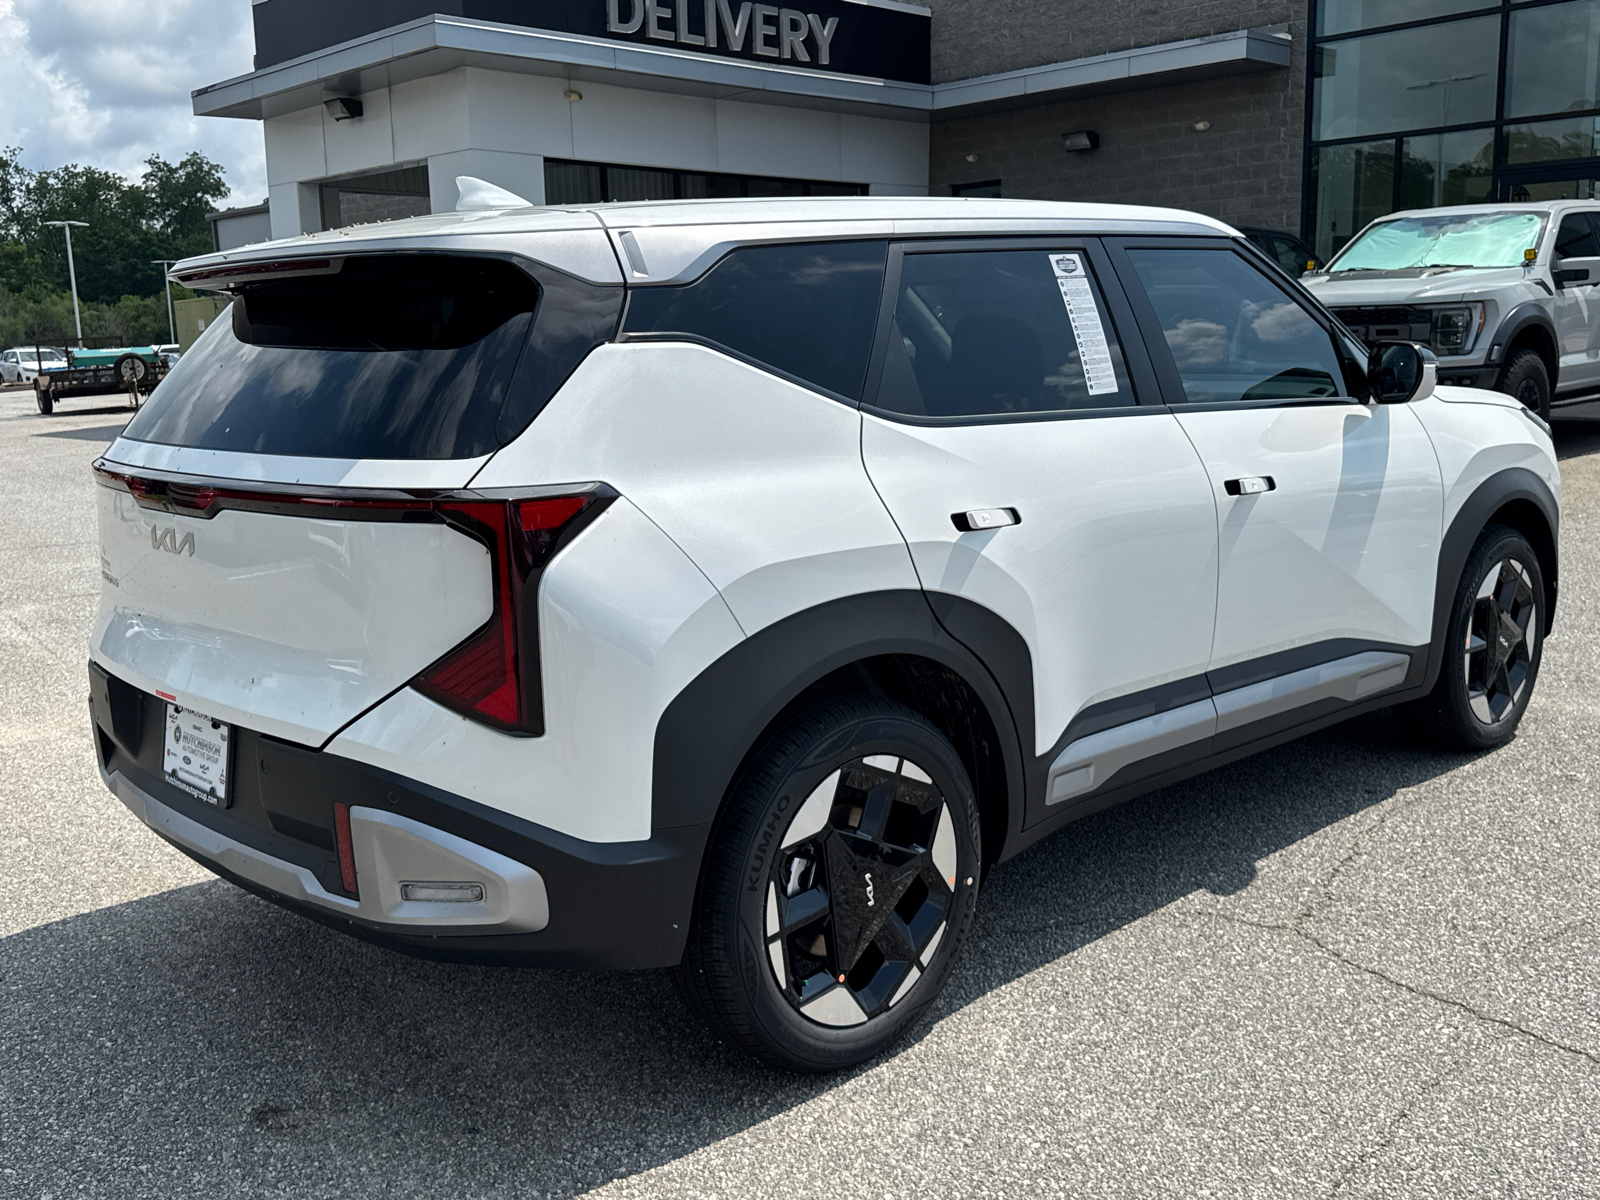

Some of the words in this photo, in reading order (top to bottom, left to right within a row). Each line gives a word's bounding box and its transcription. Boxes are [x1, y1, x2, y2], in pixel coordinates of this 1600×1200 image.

[606, 0, 839, 64] DELIVERY
[151, 524, 196, 558] KIA
[182, 732, 221, 756] HUTCHINSON
[182, 746, 205, 759] AUTOMOTIVE
[206, 753, 219, 764] GROUP
[746, 793, 791, 892] KUMHO
